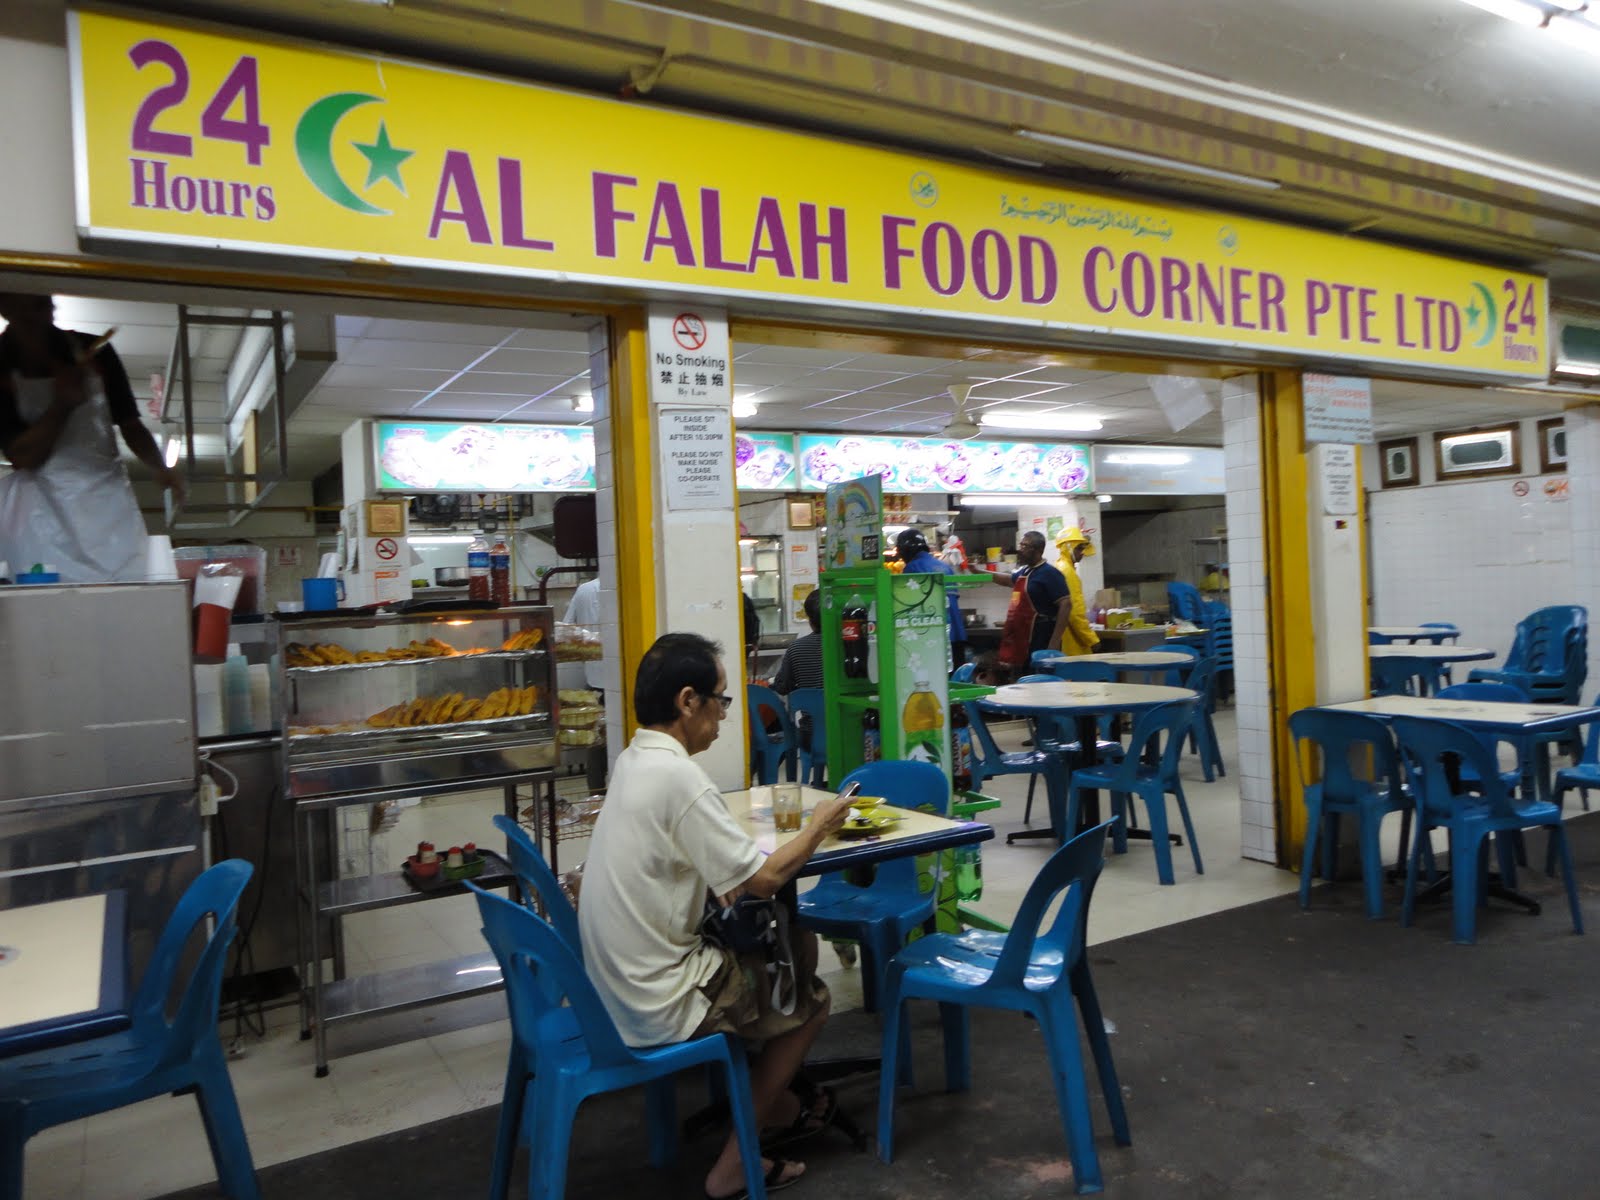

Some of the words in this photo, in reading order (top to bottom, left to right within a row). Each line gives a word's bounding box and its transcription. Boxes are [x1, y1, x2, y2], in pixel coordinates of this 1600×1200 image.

[129, 40, 269, 166] 24
[130, 157, 276, 221] Hours
[428, 150, 554, 252] AL
[591, 171, 848, 284] FALAH
[882, 215, 1058, 306] FOOD
[1083, 246, 1286, 333] CORNER
[1307, 280, 1378, 344] PTE
[1397, 294, 1460, 353] LTD
[1502, 278, 1537, 337] 24
[1503, 335, 1539, 364] Hours
[656, 352, 673, 365] No
[676, 353, 725, 371] Smoking
[660, 369, 724, 387] 禁止抽烟
[677, 387, 688, 397] By
[691, 388, 707, 396] Law
[673, 415, 702, 423] PLEASE
[683, 424, 708, 432] INSIDE
[669, 433, 693, 441] AFTER
[895, 618, 909, 628] BE
[910, 615, 944, 627] CLEAR
